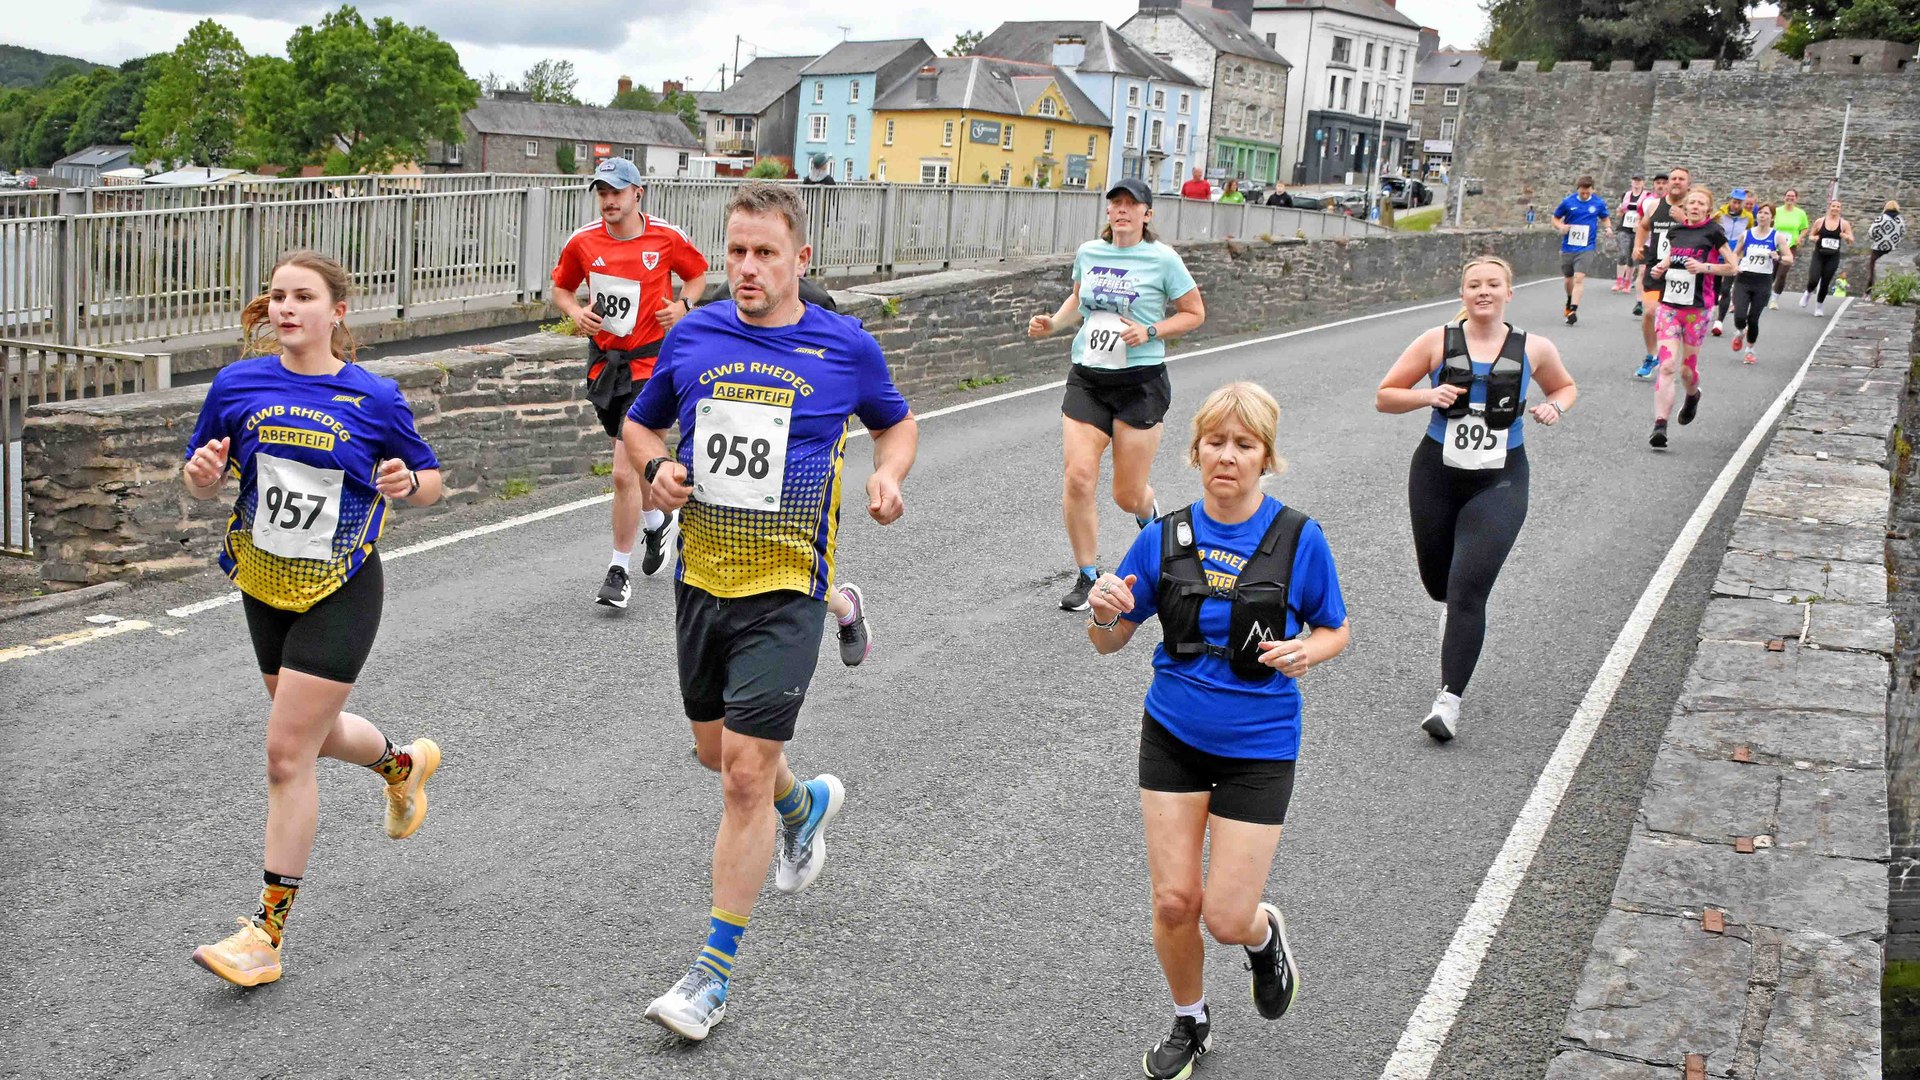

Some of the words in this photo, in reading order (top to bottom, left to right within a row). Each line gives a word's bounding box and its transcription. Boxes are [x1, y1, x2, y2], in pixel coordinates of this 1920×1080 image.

[1571, 231, 1585, 240] 921
[1749, 255, 1766, 265] 973
[1670, 280, 1690, 295] 939
[1090, 329, 1120, 352] 897
[699, 362, 745, 385] CLWB
[750, 362, 815, 397] RHEDEG
[715, 385, 790, 404] ABERTEIFI
[246, 405, 285, 431] CLWB
[289, 406, 351, 442] RHEDEG
[260, 429, 331, 448] ABERTEIFI
[1454, 423, 1497, 450] 895
[706, 433, 771, 480] 958
[266, 486, 327, 530] 957
